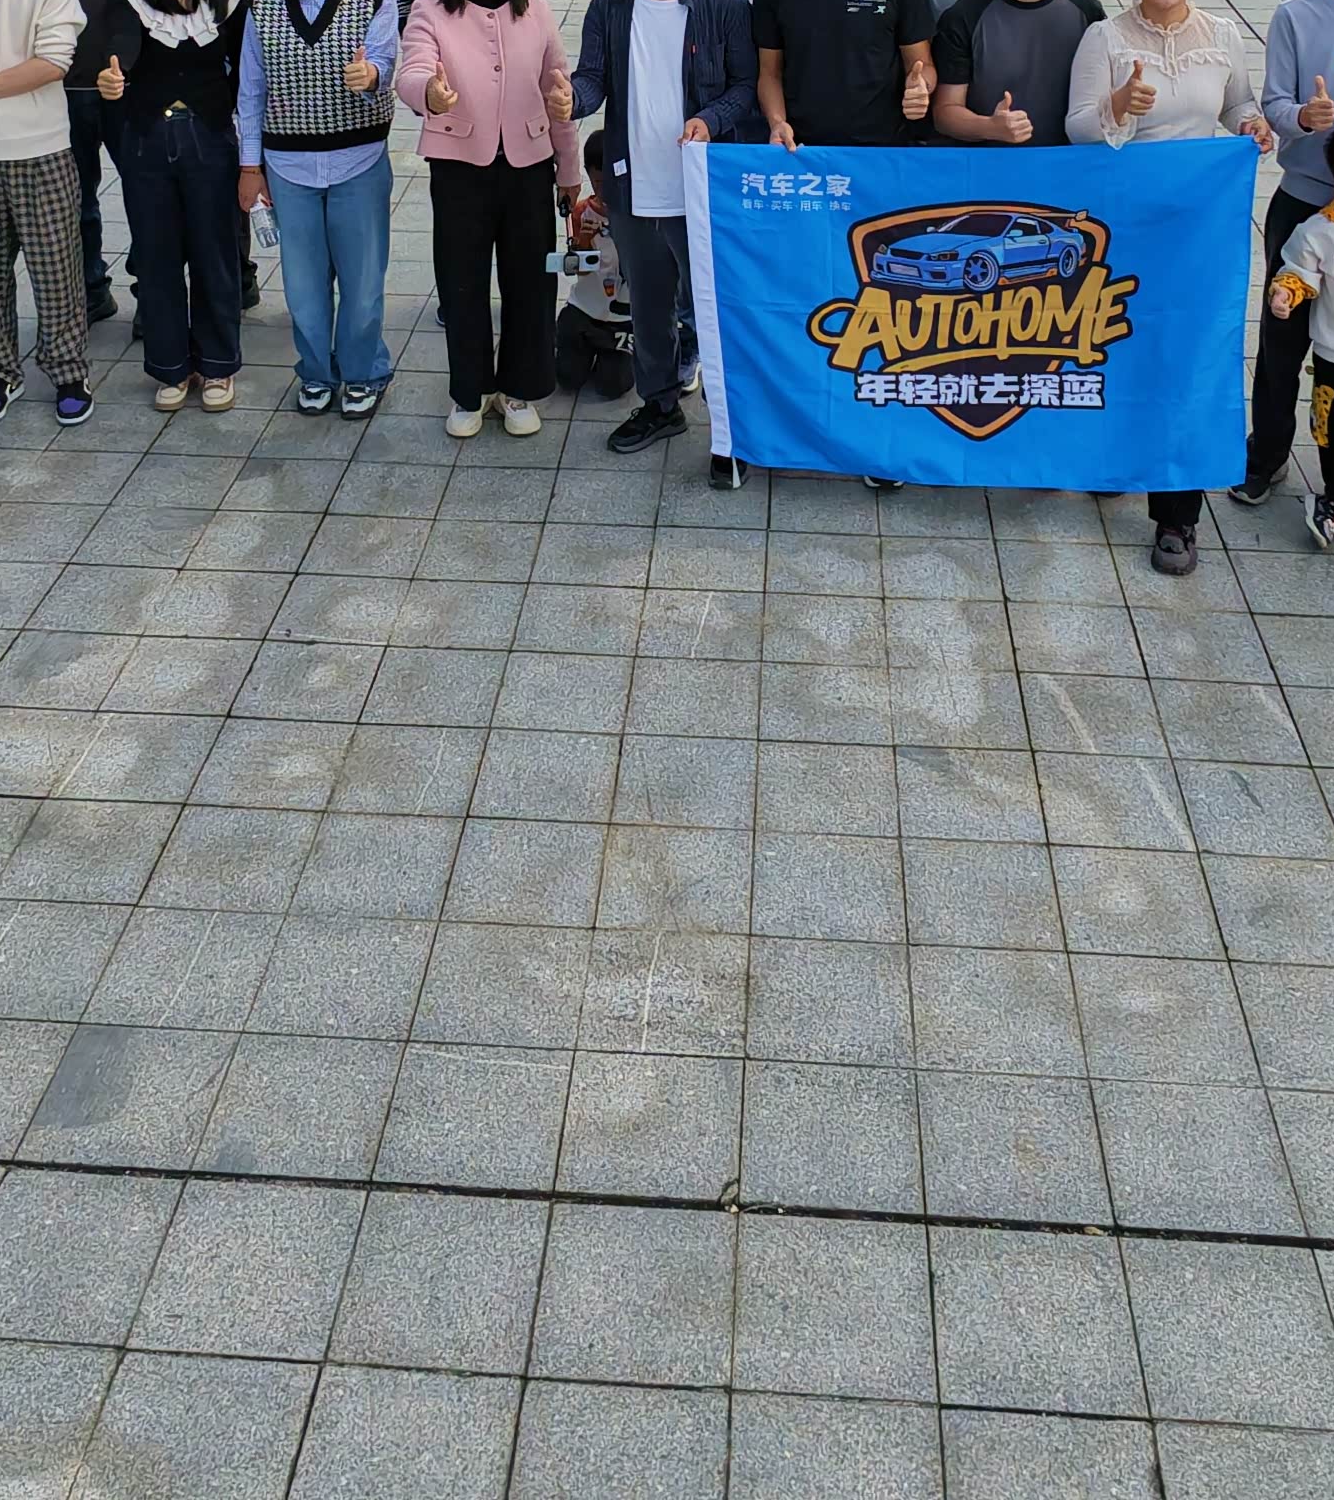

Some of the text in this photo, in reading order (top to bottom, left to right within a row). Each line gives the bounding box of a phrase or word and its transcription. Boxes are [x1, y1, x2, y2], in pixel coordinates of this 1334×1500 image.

[740, 172, 852, 197] 汽车之家
[811, 266, 1137, 366] AUTOHOME
[855, 370, 1105, 408] 年轻就去深蓝
